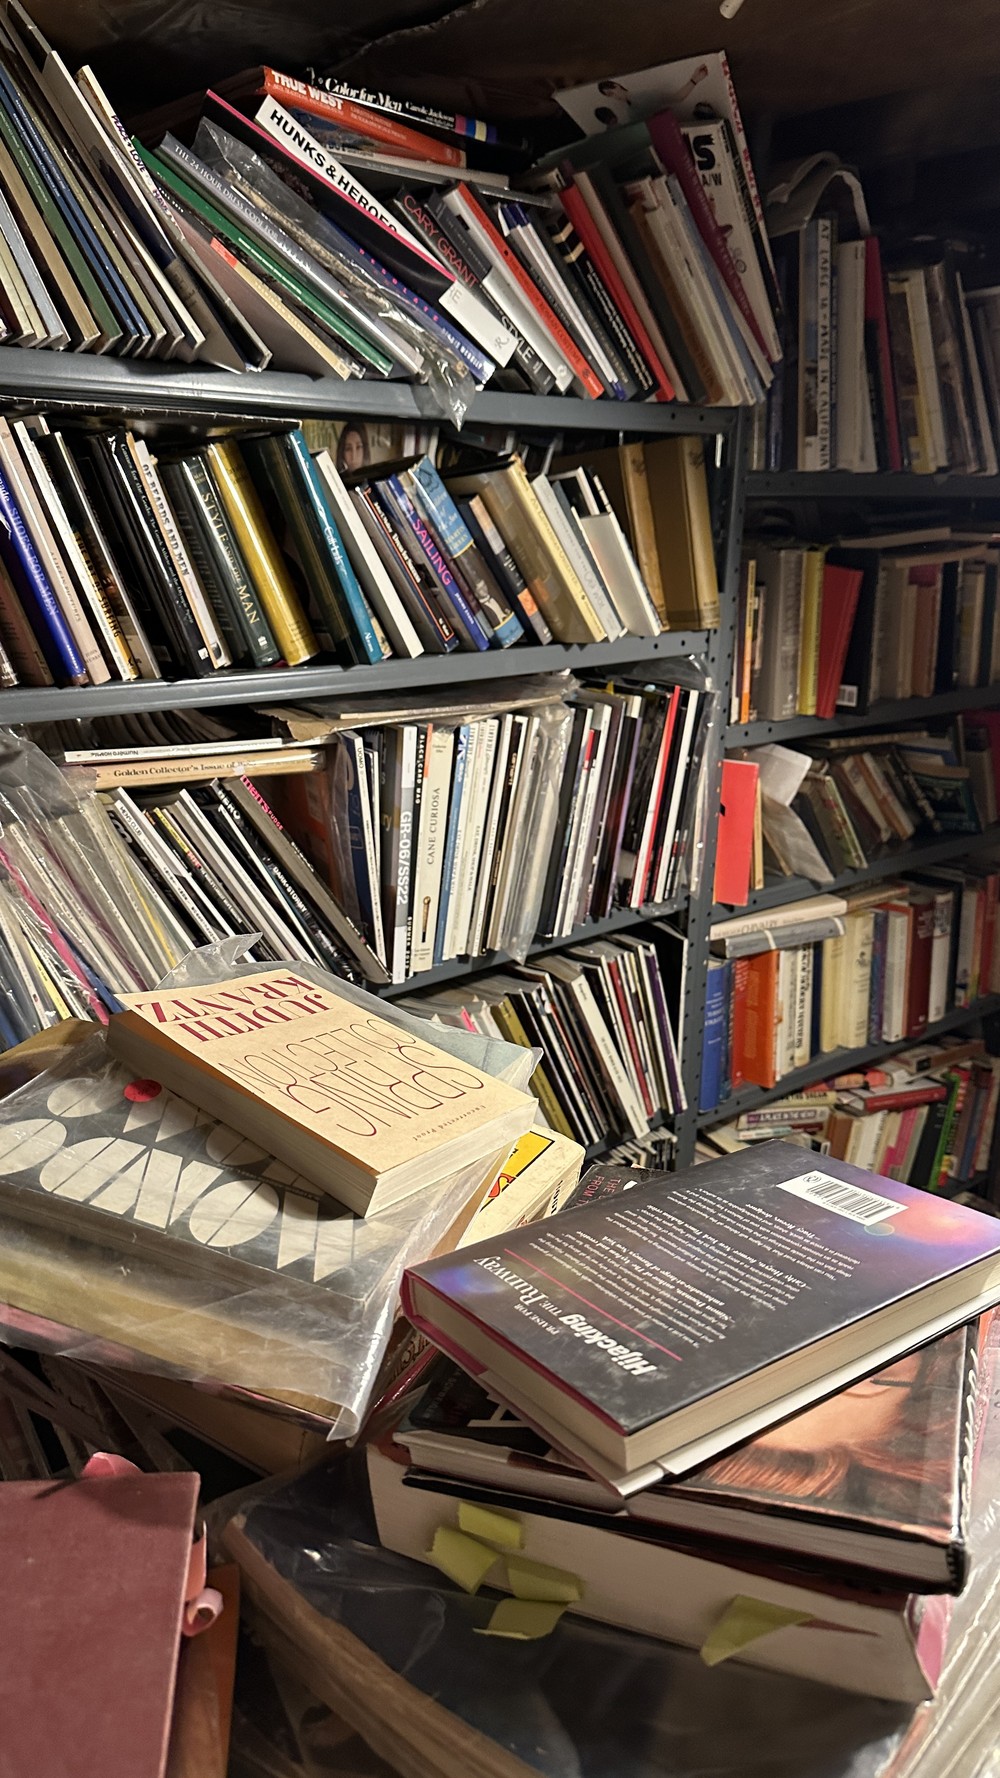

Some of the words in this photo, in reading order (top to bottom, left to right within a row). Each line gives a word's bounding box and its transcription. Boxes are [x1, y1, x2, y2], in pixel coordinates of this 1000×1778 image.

[268, 69, 311, 96] TRUE
[306, 86, 345, 111] WEST
[323, 76, 360, 100] Color
[358, 87, 378, 104] for
[375, 91, 405, 113] Men
[267, 109, 330, 169] HUNKS
[323, 163, 341, 181] &
[695, 133, 717, 170] S
[128, 147, 148, 173] LOVE
[400, 192, 438, 239] CARY
[434, 234, 479, 291] GRANT
[819, 222, 830, 241] AT
[819, 368, 830, 384] IN
[819, 390, 830, 467] CALIFORNIA
[139, 462, 153, 479] OF
[129, 469, 139, 482] for
[134, 481, 145, 497] the
[145, 480, 172, 526] BEARDS
[164, 527, 181, 551] AND
[7, 506, 33, 552] SHOES
[27, 556, 46, 584] FOR
[39, 587, 59, 616] MEN
[200, 491, 230, 543] STYLE
[222, 544, 237, 567] AND
[234, 583, 261, 625] MAN
[409, 517, 455, 587] SAILING
[173, 551, 191, 577] MEN
[74, 536, 87, 555] THE
[97, 595, 122, 638] SURFING
[355, 747, 365, 769] UOMO
[417, 734, 426, 759] BLACK
[112, 765, 148, 777] Golden
[148, 762, 198, 774] Collector's
[200, 761, 225, 770] Issue
[415, 762, 424, 785] CARD
[215, 787, 242, 822] HERO
[413, 787, 422, 805] MAG
[117, 805, 134, 824] MEN'S
[128, 820, 143, 837] CLUB
[266, 809, 284, 831] FUDGE
[428, 786, 441, 834] CURIOSA
[395, 810, 412, 906] GR-06/SS22
[425, 836, 437, 866] CANE
[404, 915, 413, 946] SUMMER
[135, 976, 314, 1024] KRANTZ
[178, 992, 332, 1042] JUDITH
[217, 1018, 417, 1094] COLLECTION
[278, 1045, 484, 1137] SPRING
[438, 1104, 486, 1131] Uncorrected
[412, 1123, 437, 1141] Proof
[582, 1174, 604, 1202] FROM
[604, 1177, 621, 1197] THE
[643, 1203, 665, 1213] critic
[658, 1211, 687, 1224] fashion
[742, 1202, 775, 1218] designer
[681, 1222, 705, 1235] Times
[769, 1216, 797, 1229] Reese,
[793, 1227, 823, 1241] —Tracy
[572, 1229, 600, 1244] creative
[598, 1235, 619, 1245] York
[612, 1243, 631, 1252] New
[699, 1233, 721, 1243] York
[715, 1241, 736, 1251] New
[605, 1248, 633, 1264] Asylum
[624, 1250, 655, 1267] Barneys
[730, 1249, 760, 1263] former
[464, 1252, 555, 1306] Runway
[648, 1275, 677, 1289] author
[718, 1279, 742, 1291] Runway
[780, 1273, 814, 1290] —Cathy
[511, 1303, 534, 1316] FOR
[537, 1299, 566, 1316] THE
[527, 1314, 561, 1335] PRAISE
[553, 1310, 663, 1377] Hijacking
